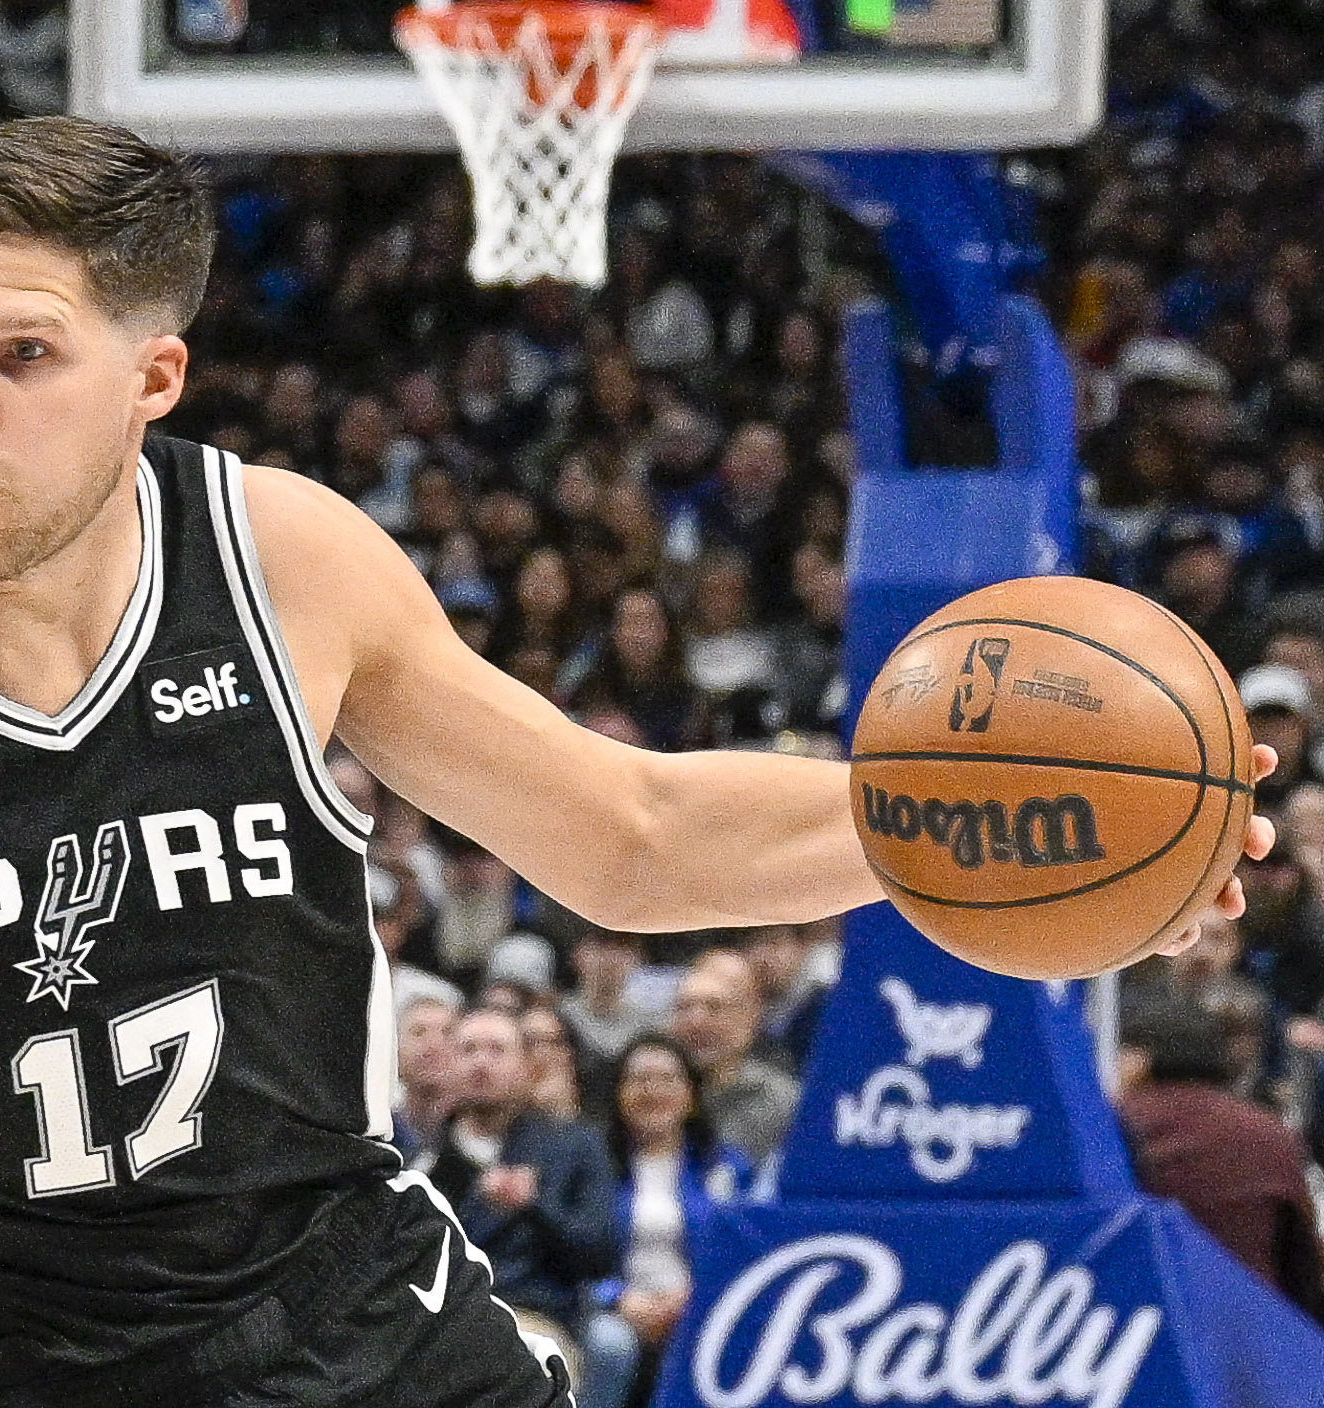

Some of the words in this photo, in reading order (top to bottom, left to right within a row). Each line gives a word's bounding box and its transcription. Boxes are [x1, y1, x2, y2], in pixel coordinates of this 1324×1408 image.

[150, 662, 253, 724] Self.
[861, 780, 1107, 870] Wilson
[10, 977, 225, 1200] 17
[834, 1065, 1031, 1182] Kroger
